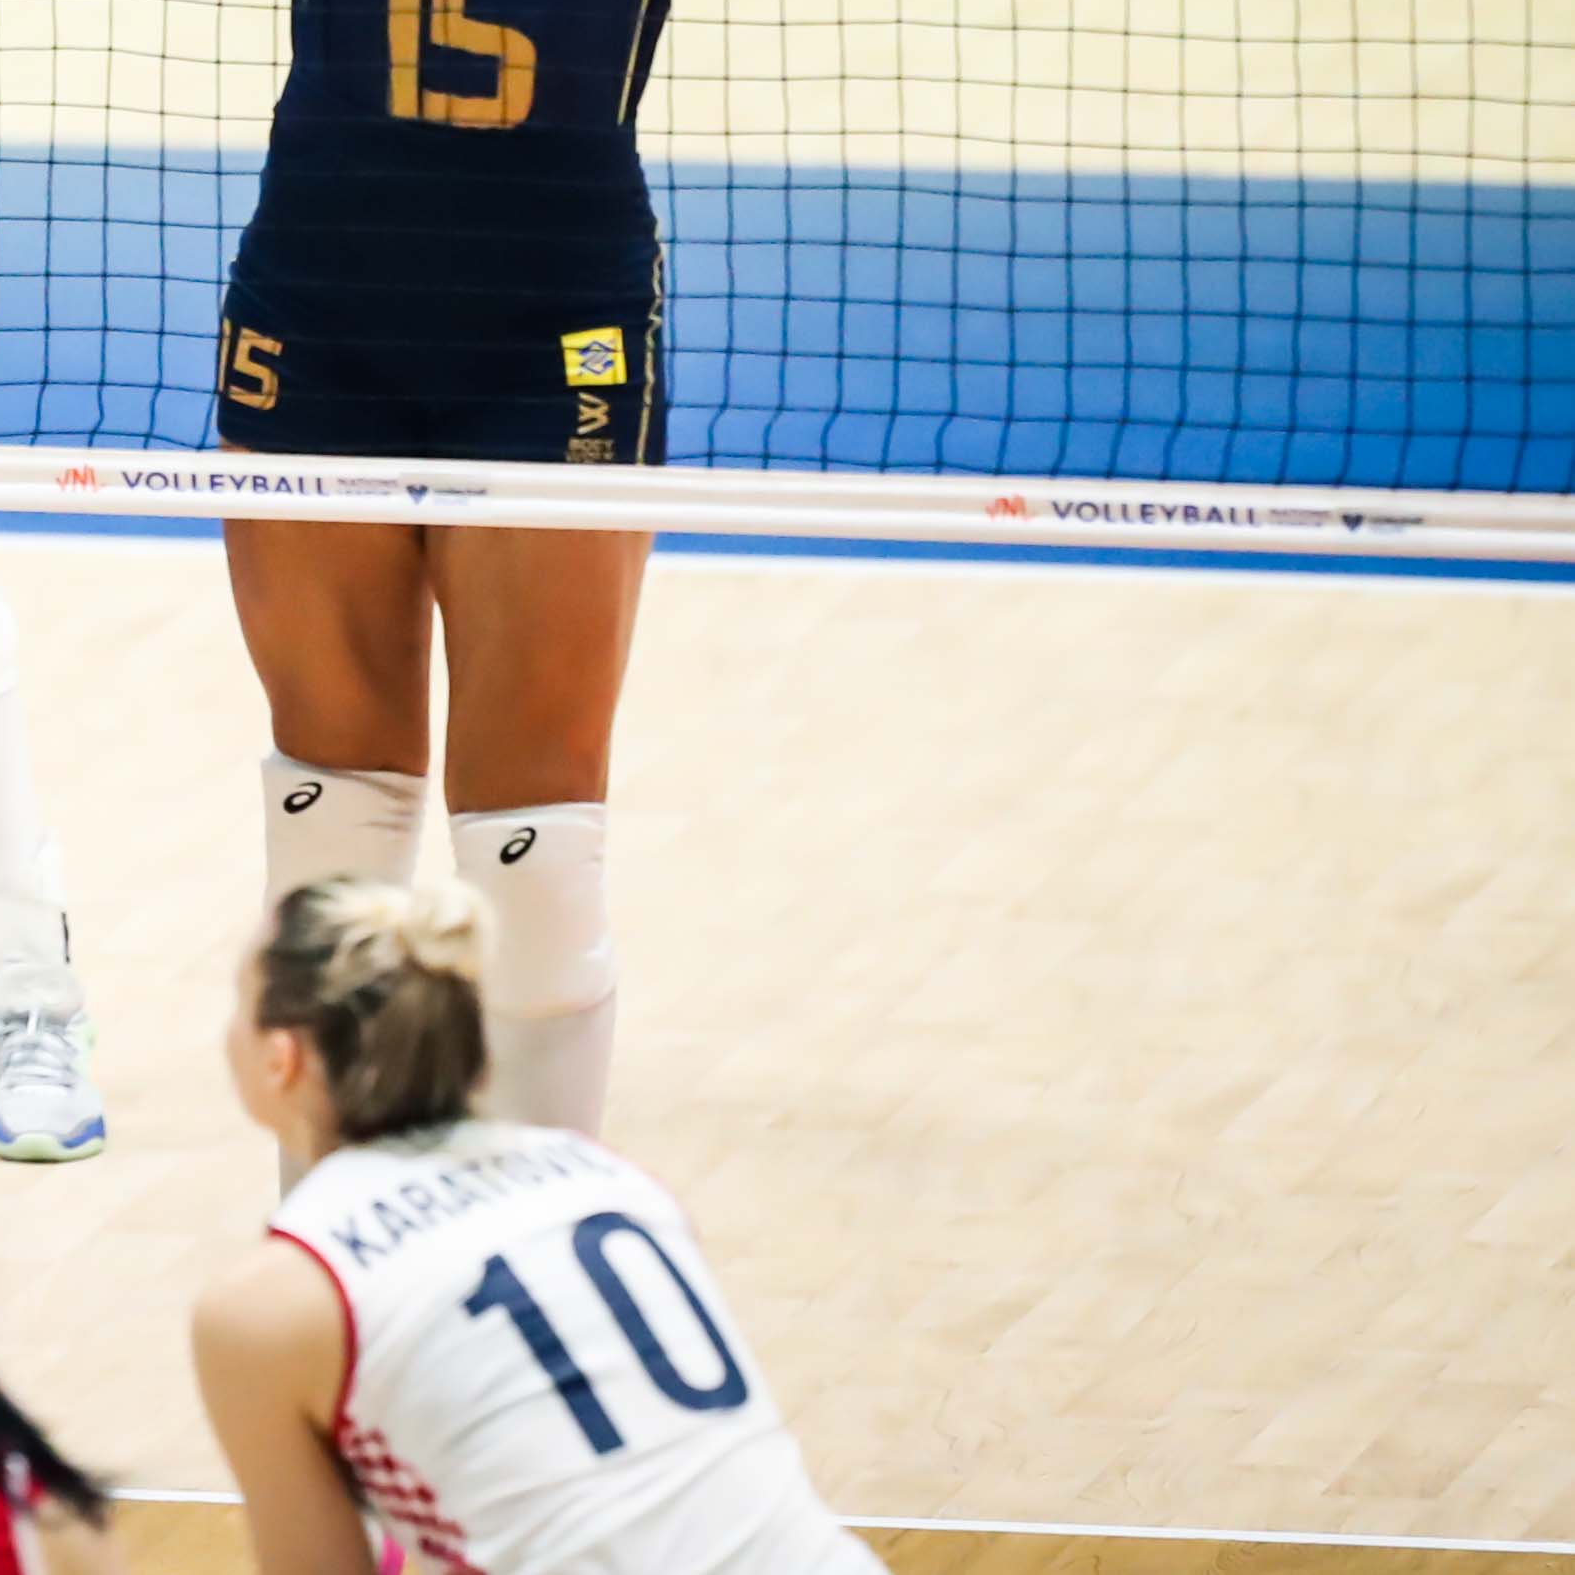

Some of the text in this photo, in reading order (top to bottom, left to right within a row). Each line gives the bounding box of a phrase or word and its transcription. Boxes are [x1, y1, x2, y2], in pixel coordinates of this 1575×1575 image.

[121, 471, 330, 497] VOLLEYBALL
[1051, 500, 1262, 528] VOLLEYBALL
[460, 1210, 750, 1457] 10
